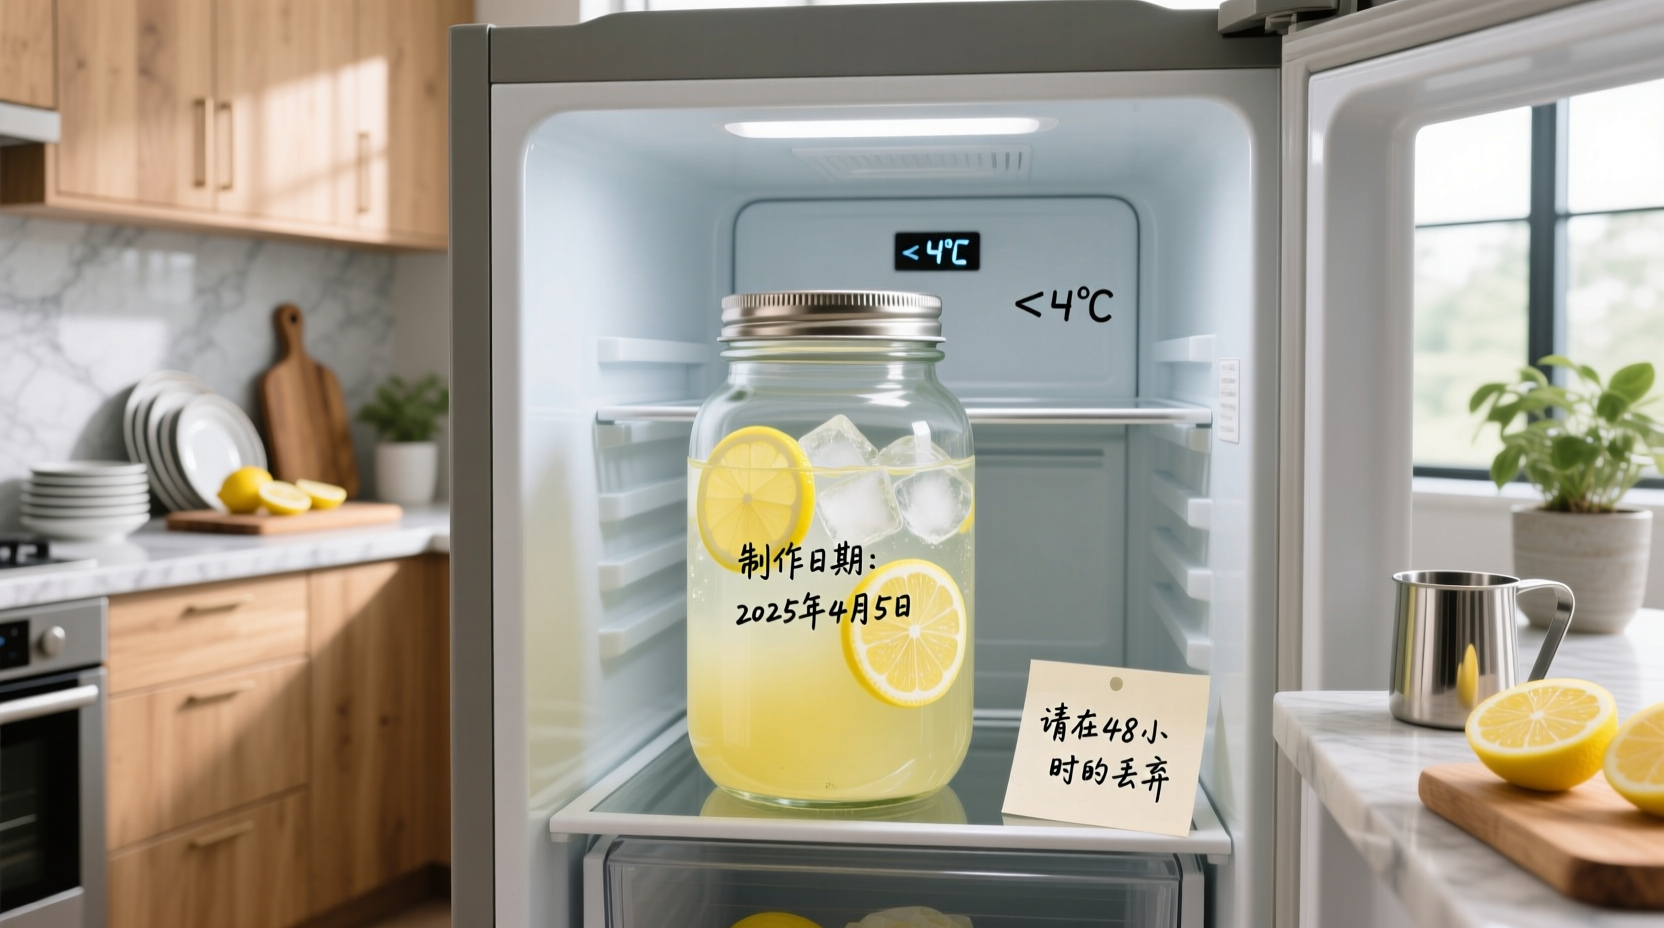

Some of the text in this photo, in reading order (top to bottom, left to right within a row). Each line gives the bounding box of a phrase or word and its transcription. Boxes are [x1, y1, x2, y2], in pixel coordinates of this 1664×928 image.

[1014, 285, 1114, 324] <4°C
[738, 540, 876, 581] 制作日期：
[735, 591, 912, 631] 2025年4月5日
[1040, 702, 1168, 744] 请在48小
[1049, 754, 1170, 803] 时的丢弃
